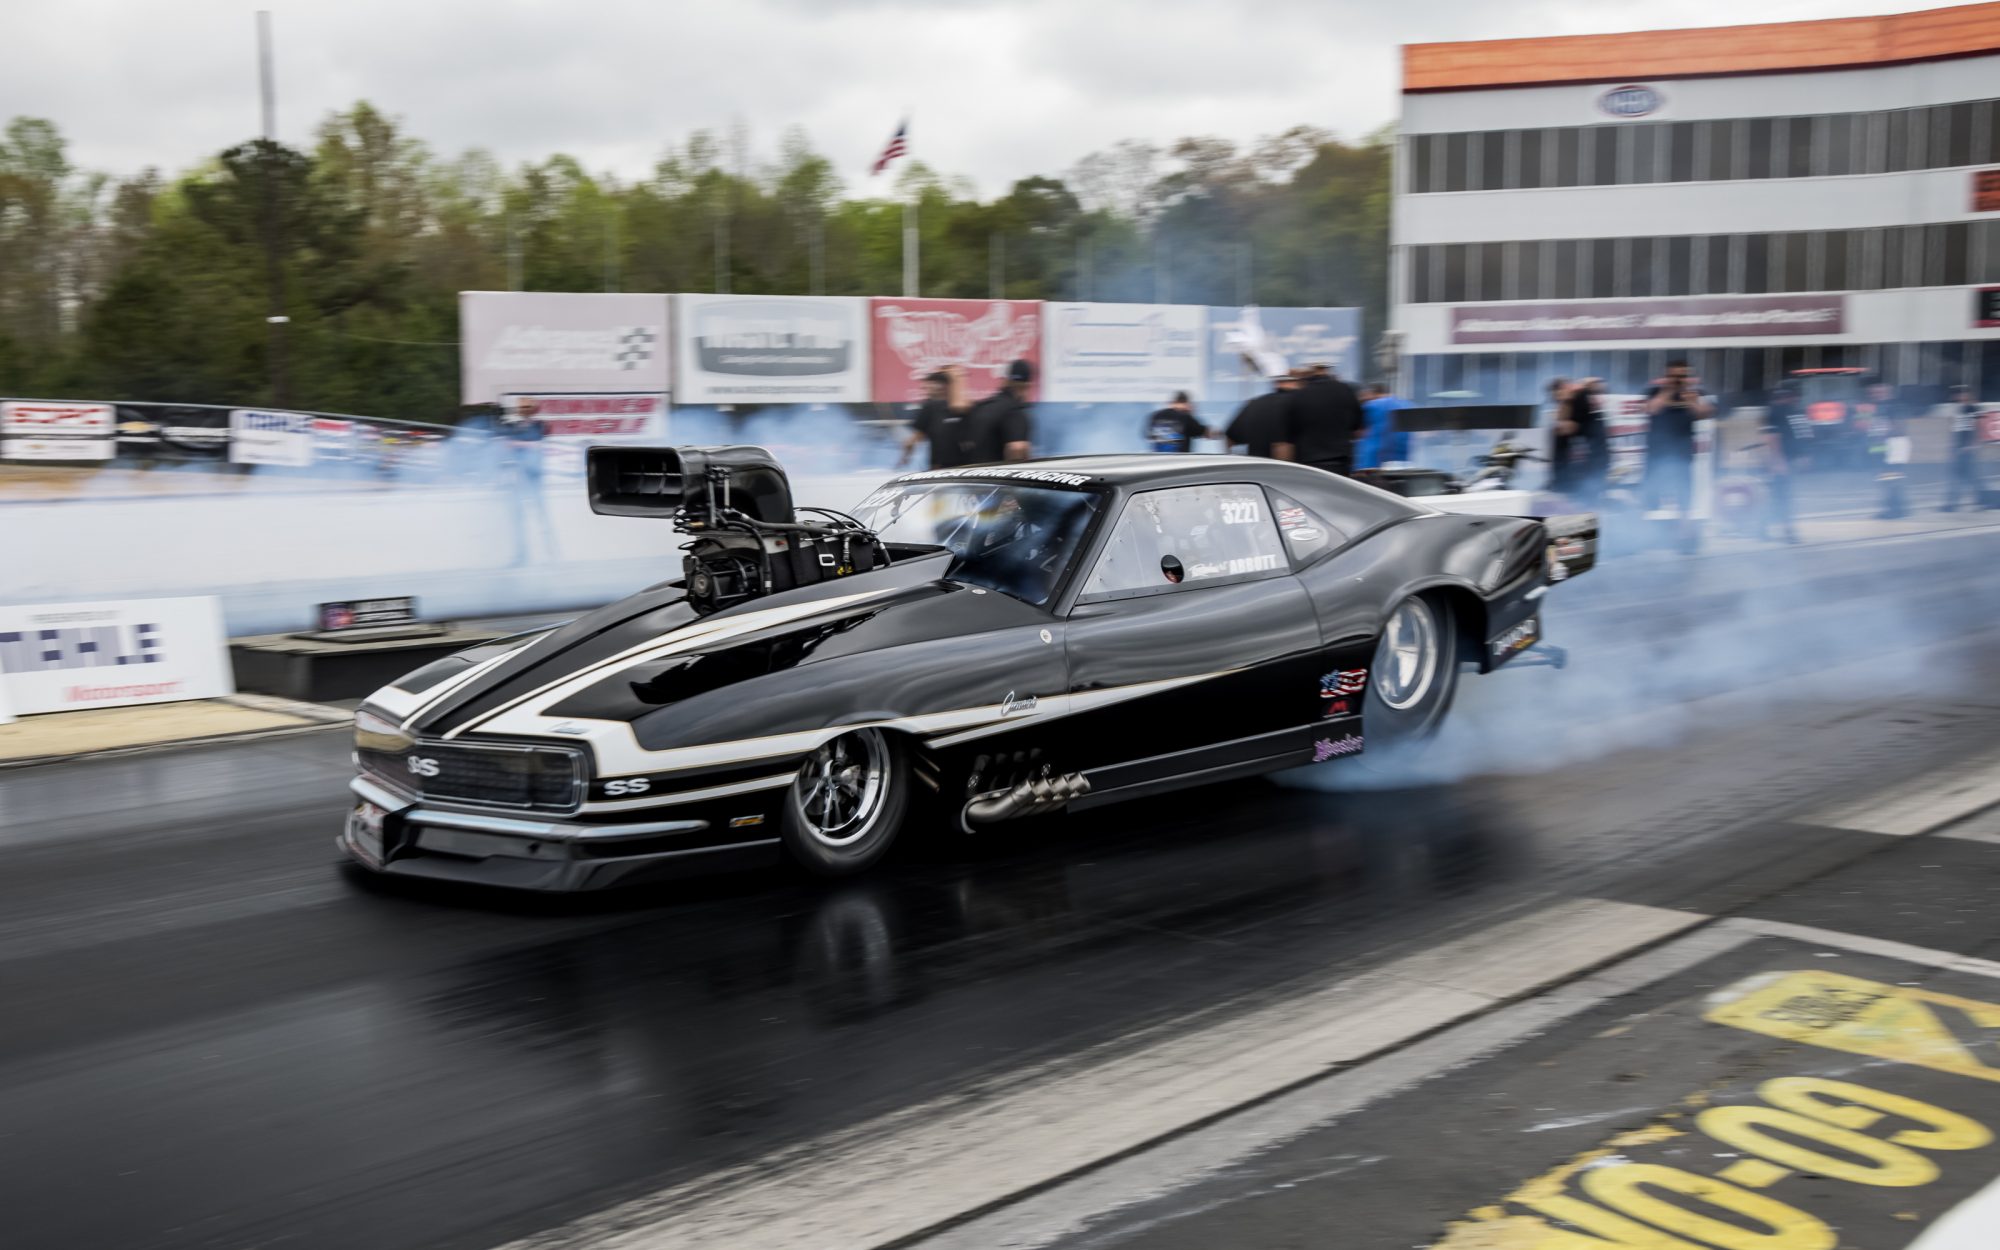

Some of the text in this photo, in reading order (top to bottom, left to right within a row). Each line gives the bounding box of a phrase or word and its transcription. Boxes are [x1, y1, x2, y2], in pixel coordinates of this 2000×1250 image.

[1012, 470, 1092, 486] RACING
[1220, 501, 1260, 525] 3227
[604, 778, 651, 796] SS
